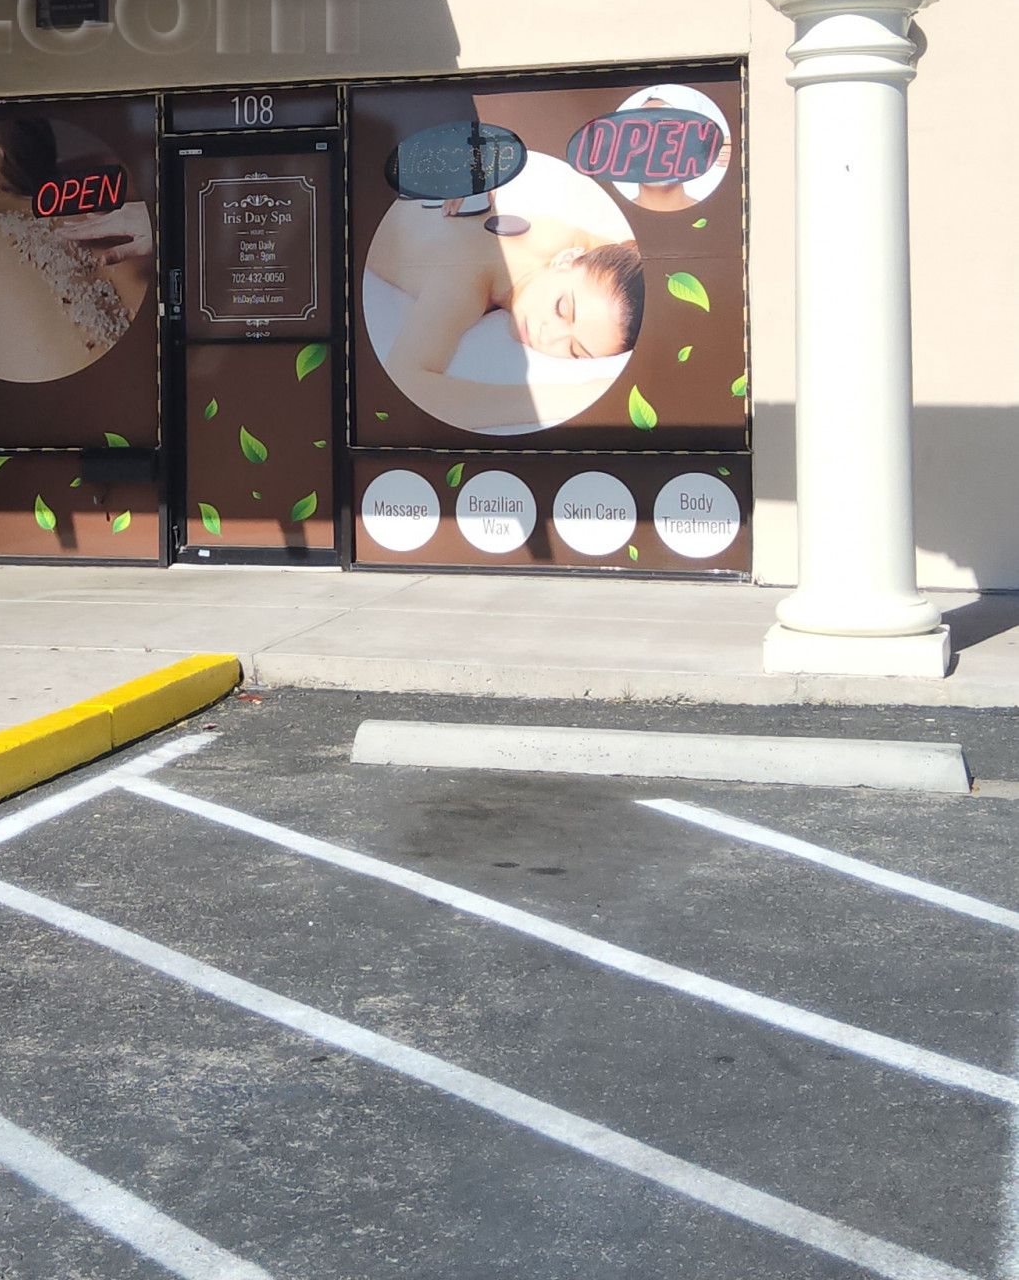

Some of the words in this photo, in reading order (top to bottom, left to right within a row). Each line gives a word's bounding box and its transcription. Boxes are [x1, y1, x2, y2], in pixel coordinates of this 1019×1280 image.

[231, 94, 274, 126] 108
[576, 120, 720, 177] OPEN
[37, 171, 122, 216] OPEN
[223, 212, 242, 224] Iris
[245, 211, 268, 226] Day
[271, 210, 292, 225] Spa
[240, 240, 258, 252] Open
[258, 241, 275, 251] Daily
[232, 272, 285, 284] 702-432-0050
[373, 499, 429, 521] Massage
[468, 495, 524, 514] Brazilian
[562, 501, 593, 521] Skin
[595, 502, 627, 522] Care
[679, 492, 714, 514] Body
[482, 516, 511, 537] Wax
[661, 515, 732, 537] Treatment
